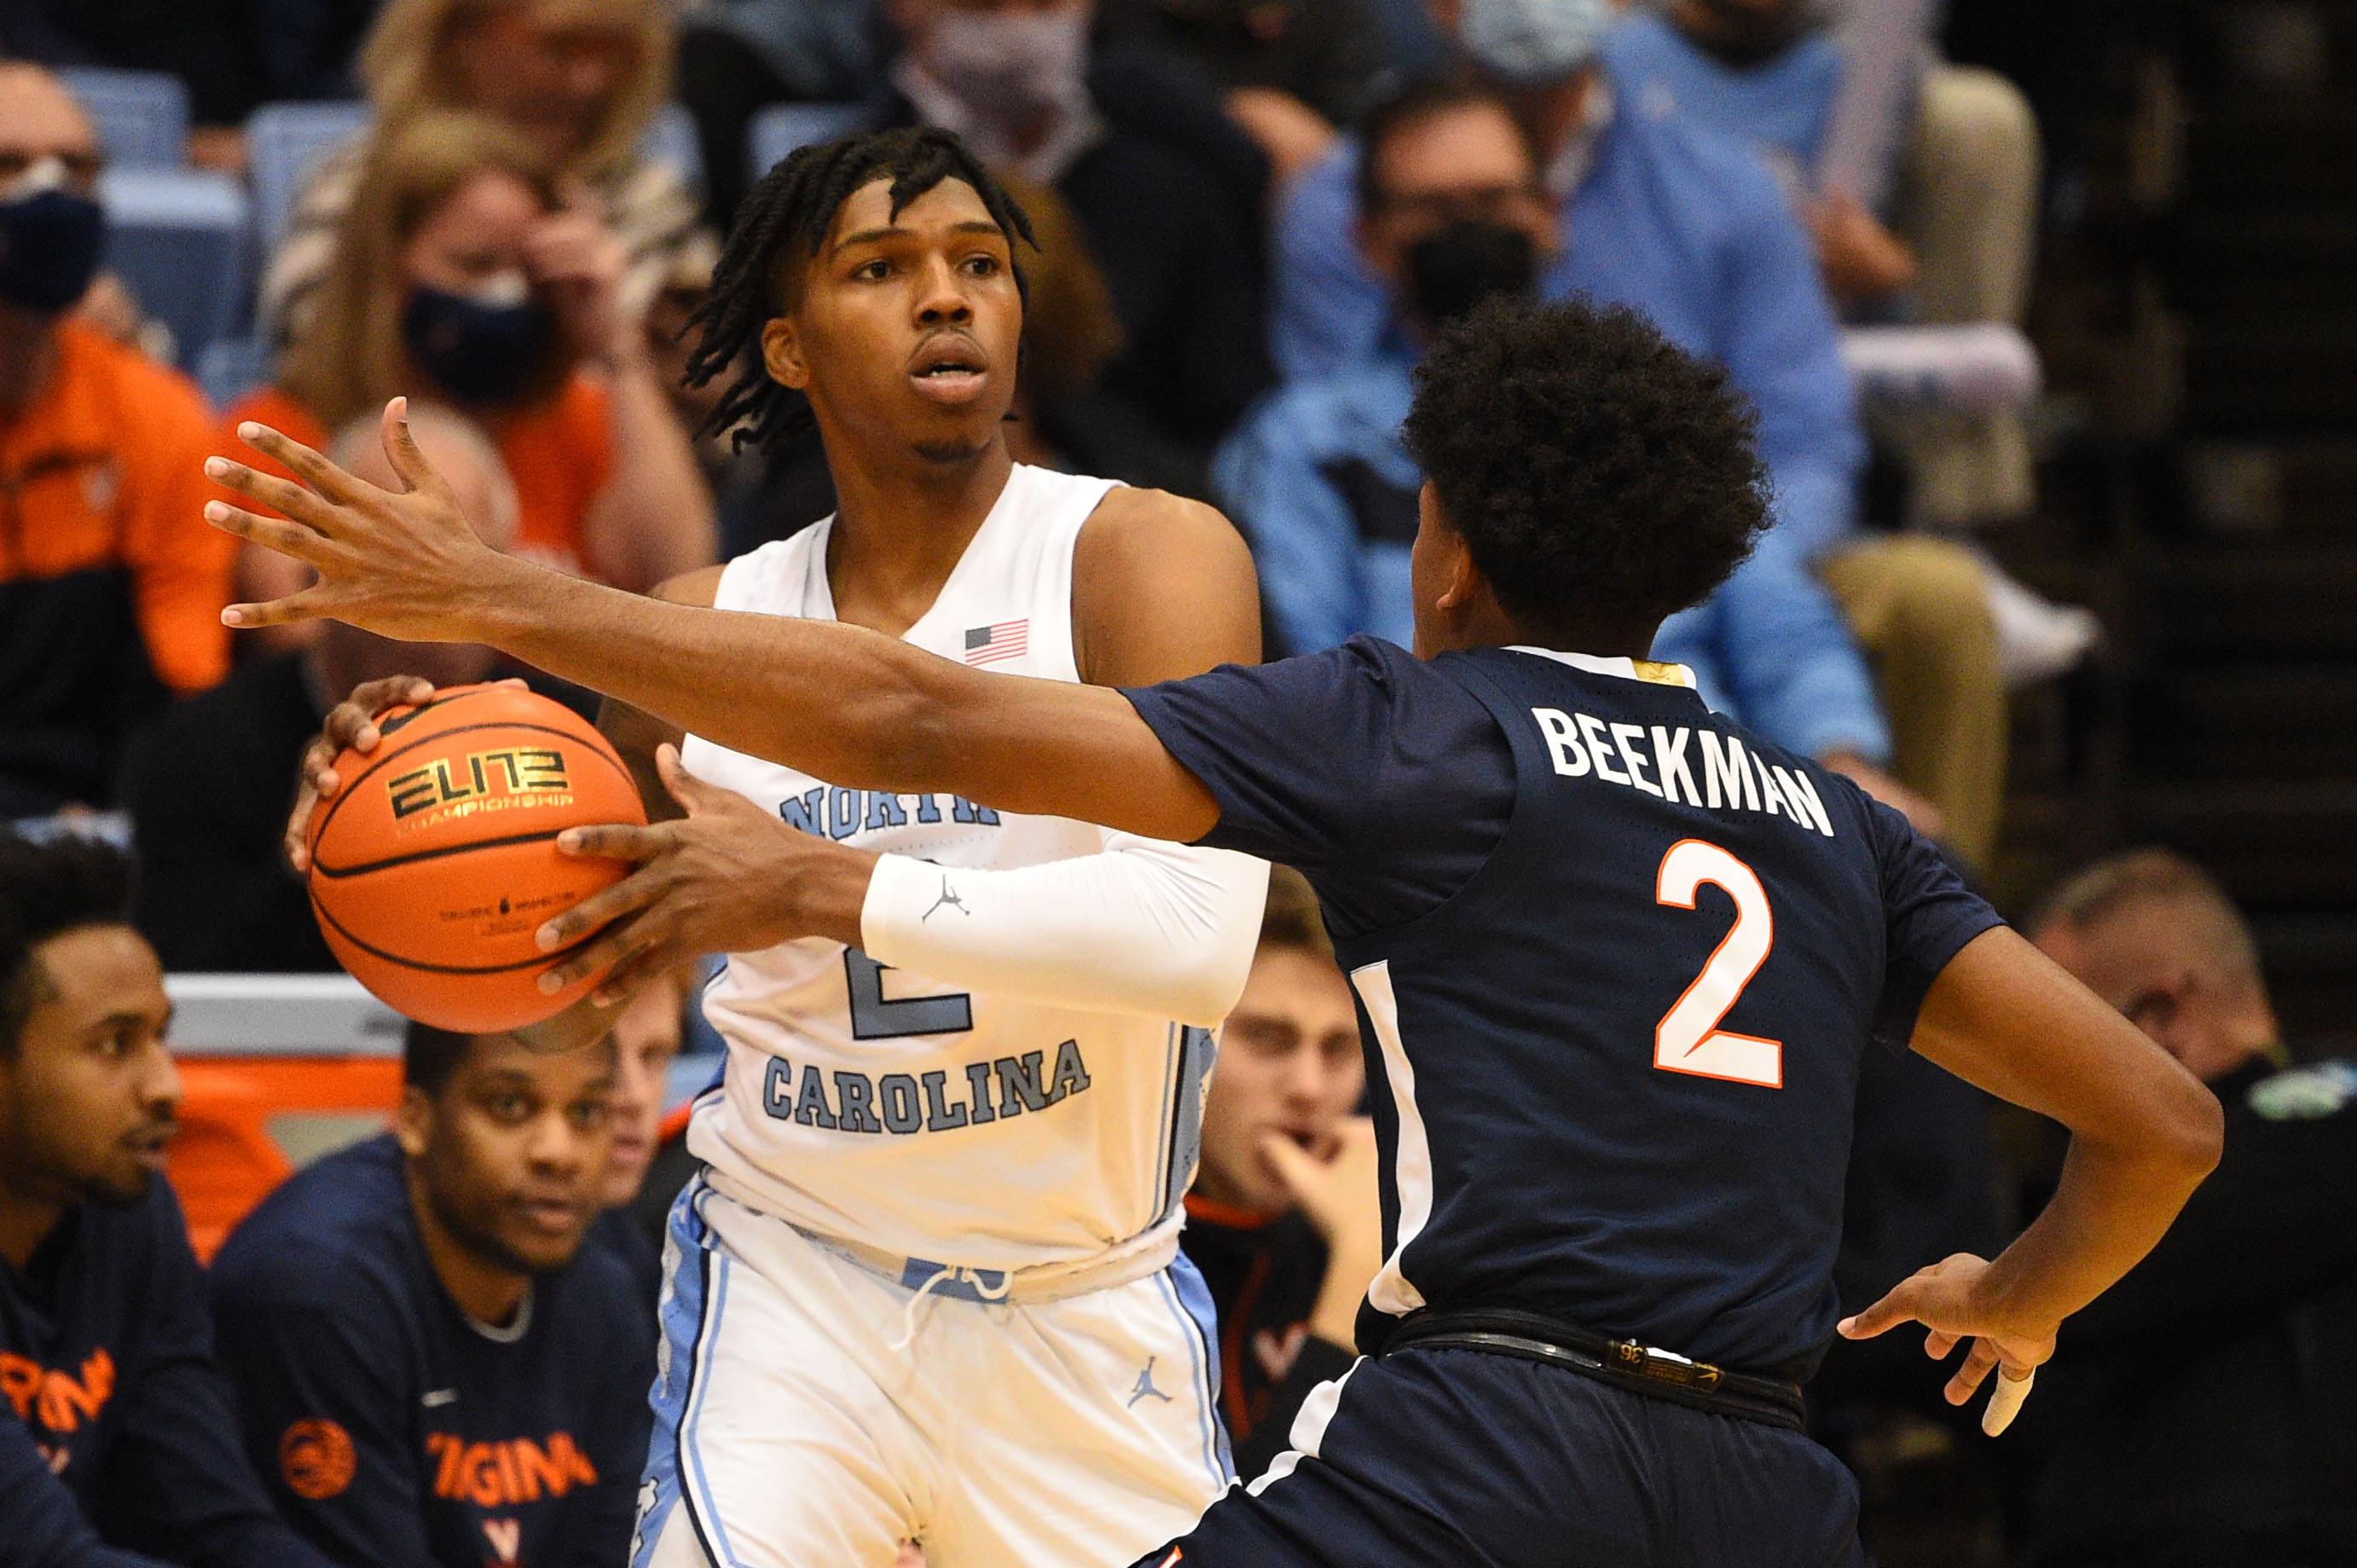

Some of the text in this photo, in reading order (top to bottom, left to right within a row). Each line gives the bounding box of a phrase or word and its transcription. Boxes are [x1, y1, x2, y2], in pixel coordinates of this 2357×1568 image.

[387, 746, 571, 820] ELITE
[395, 794, 574, 839] HAMPIONSHIP
[1532, 707, 1834, 837] BEEKMAN
[1653, 838, 1783, 1089] 2
[763, 1039, 1091, 1134] CAROLINA
